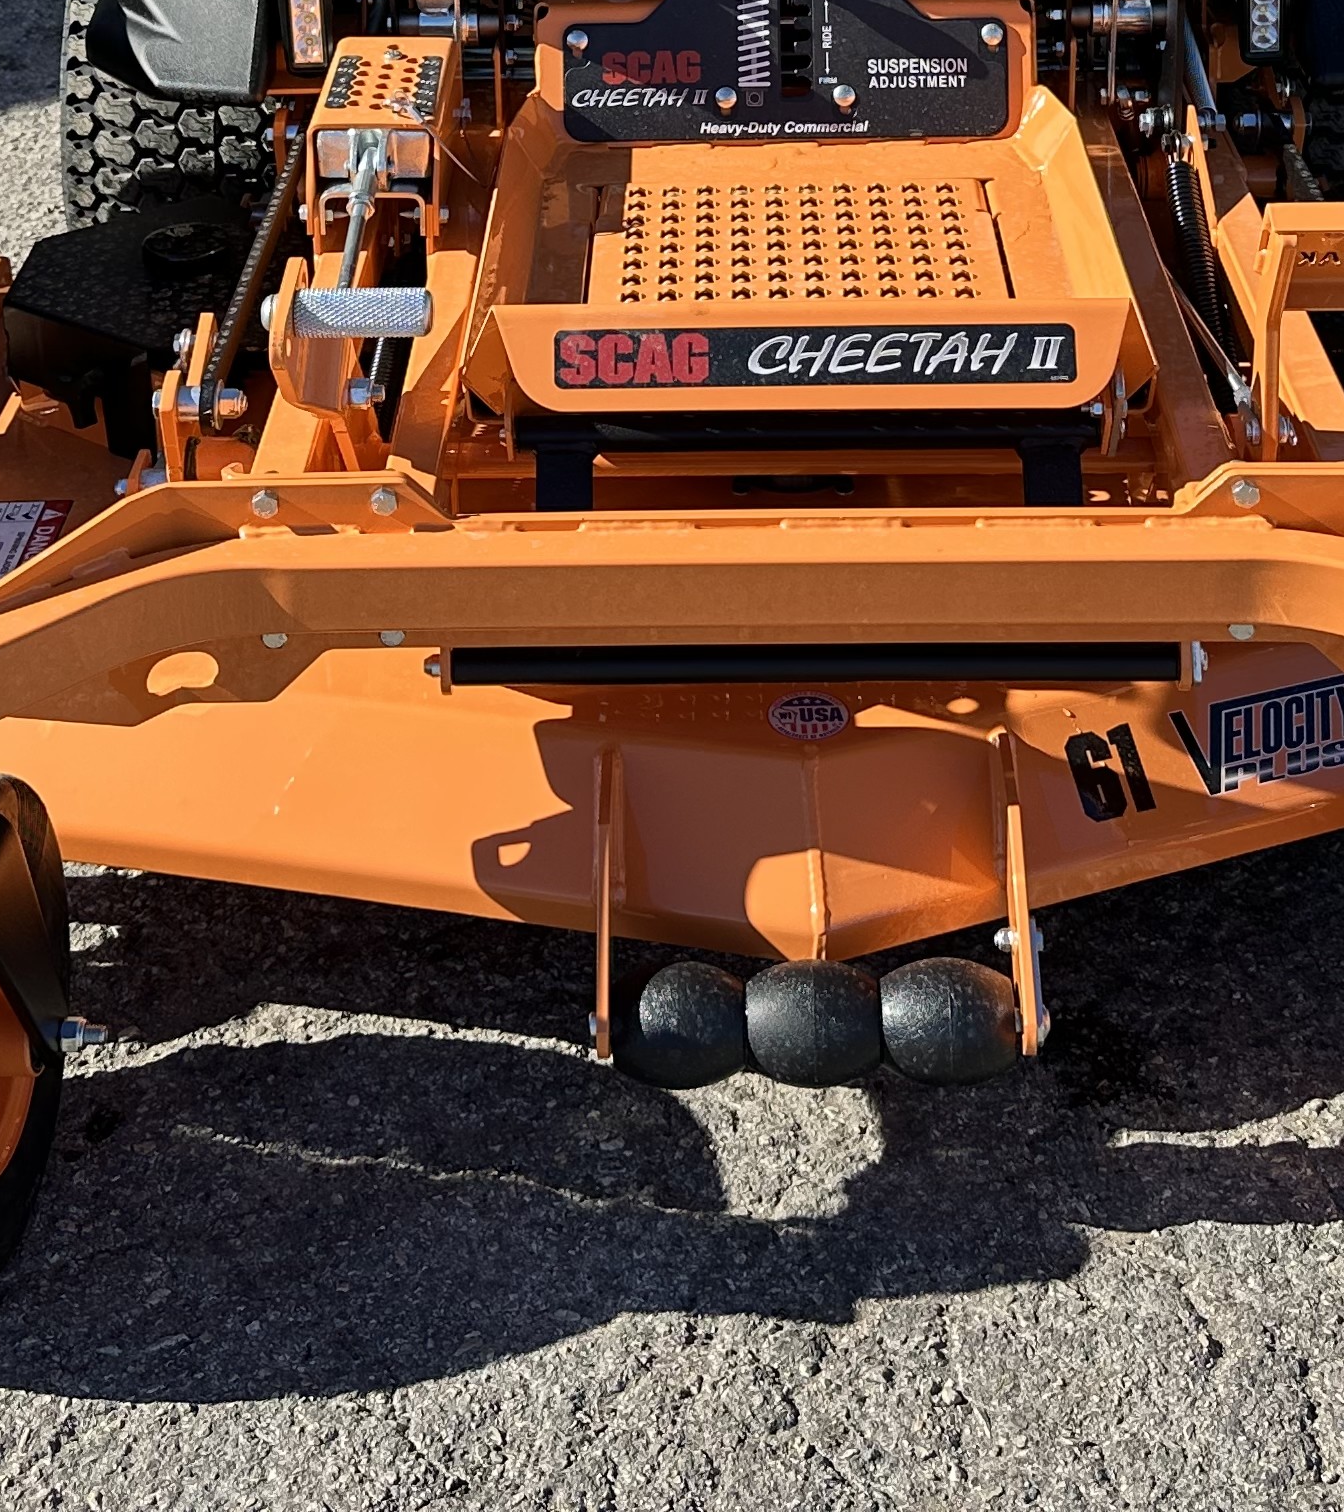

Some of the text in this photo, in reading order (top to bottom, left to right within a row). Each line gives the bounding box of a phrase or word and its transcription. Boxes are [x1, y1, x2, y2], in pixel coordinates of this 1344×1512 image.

[822, 25, 832, 49] RIDE
[601, 50, 702, 85] SCAG
[867, 58, 968, 74] SUSPENSION
[818, 76, 838, 84] FIRM
[868, 75, 967, 88] ADJUSTMENT
[571, 89, 709, 108] CHEETAH II
[700, 120, 869, 136] Heavy-Duty Commercial
[558, 333, 1061, 385] SCAG CHEETAH II
[799, 707, 844, 722] USA
[1064, 722, 1156, 822] 61
